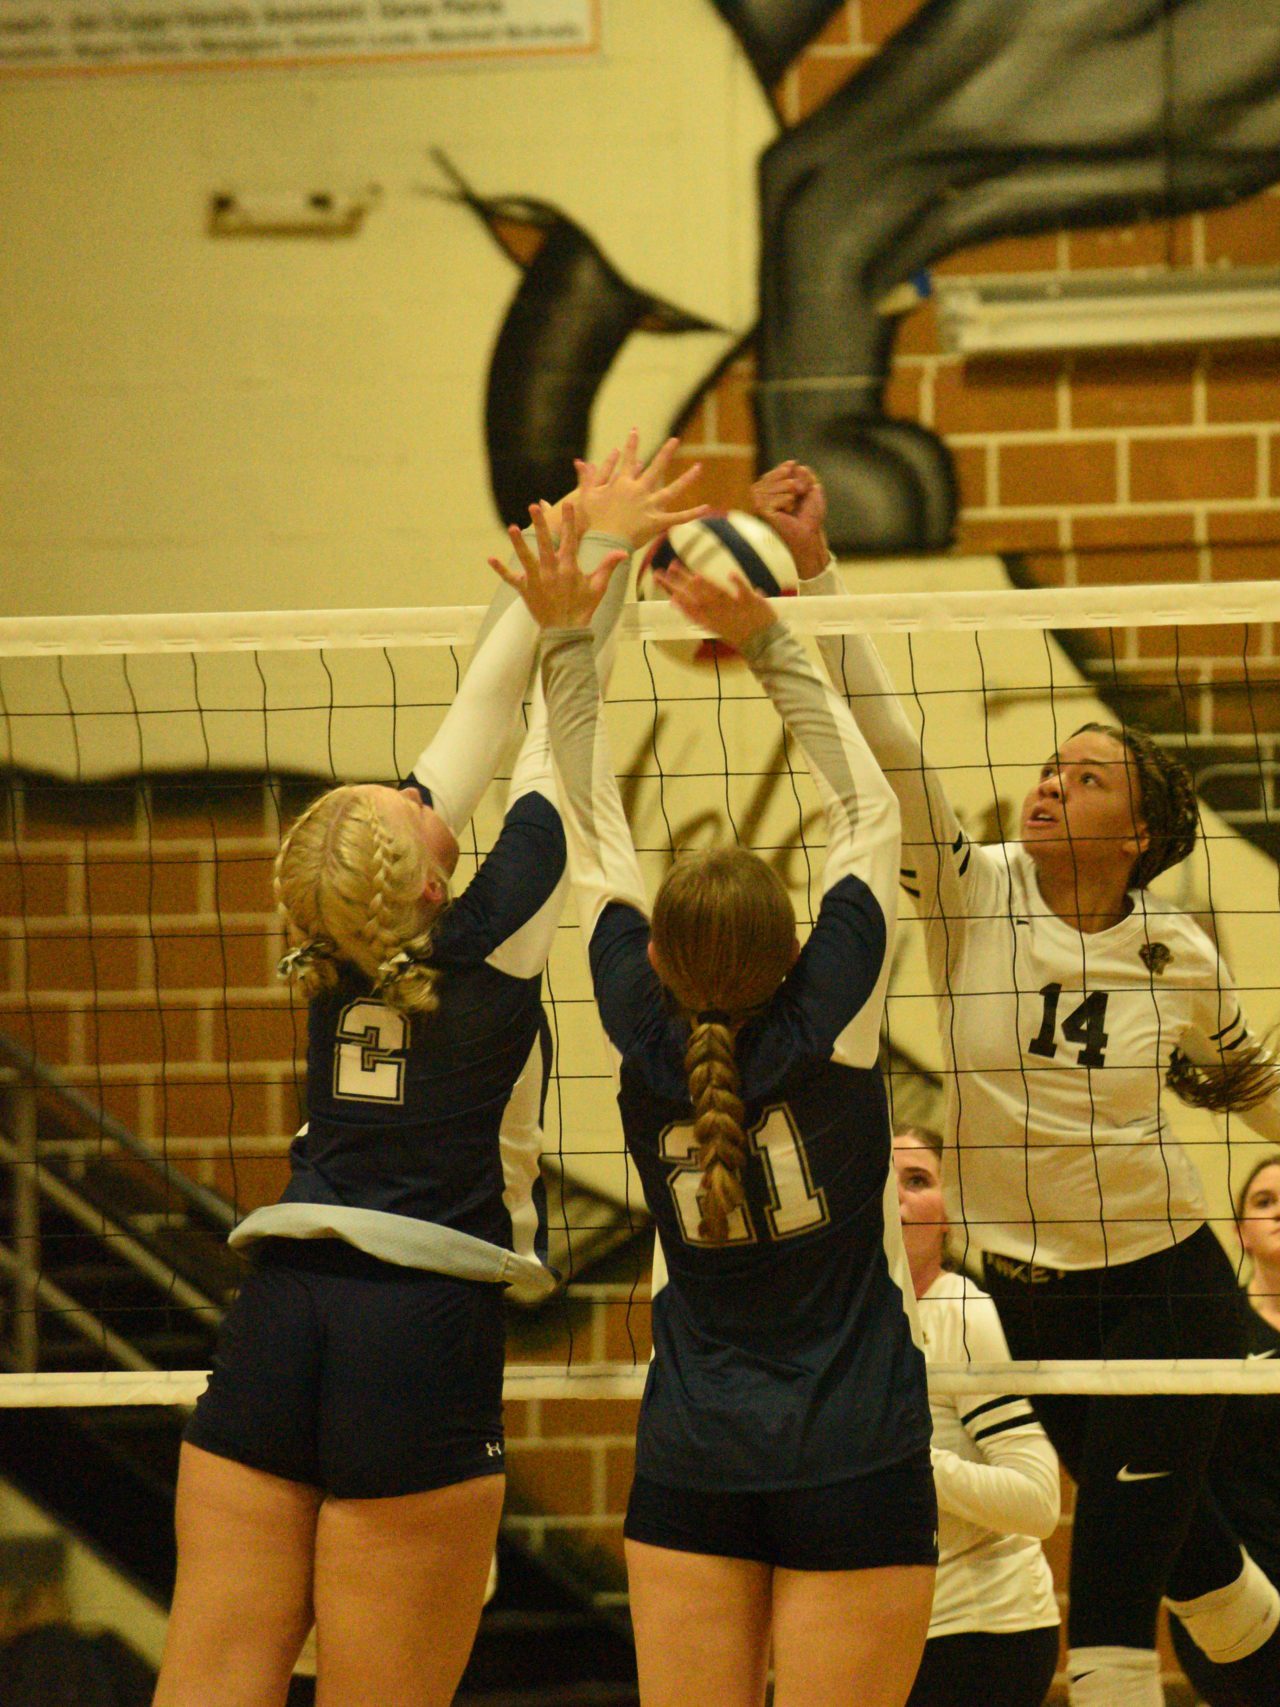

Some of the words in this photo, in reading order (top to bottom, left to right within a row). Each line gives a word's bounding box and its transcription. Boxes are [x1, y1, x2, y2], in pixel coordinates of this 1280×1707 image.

[333, 997, 411, 1105] 2
[1028, 982, 1108, 1069] 14
[659, 1102, 831, 1248] 21
